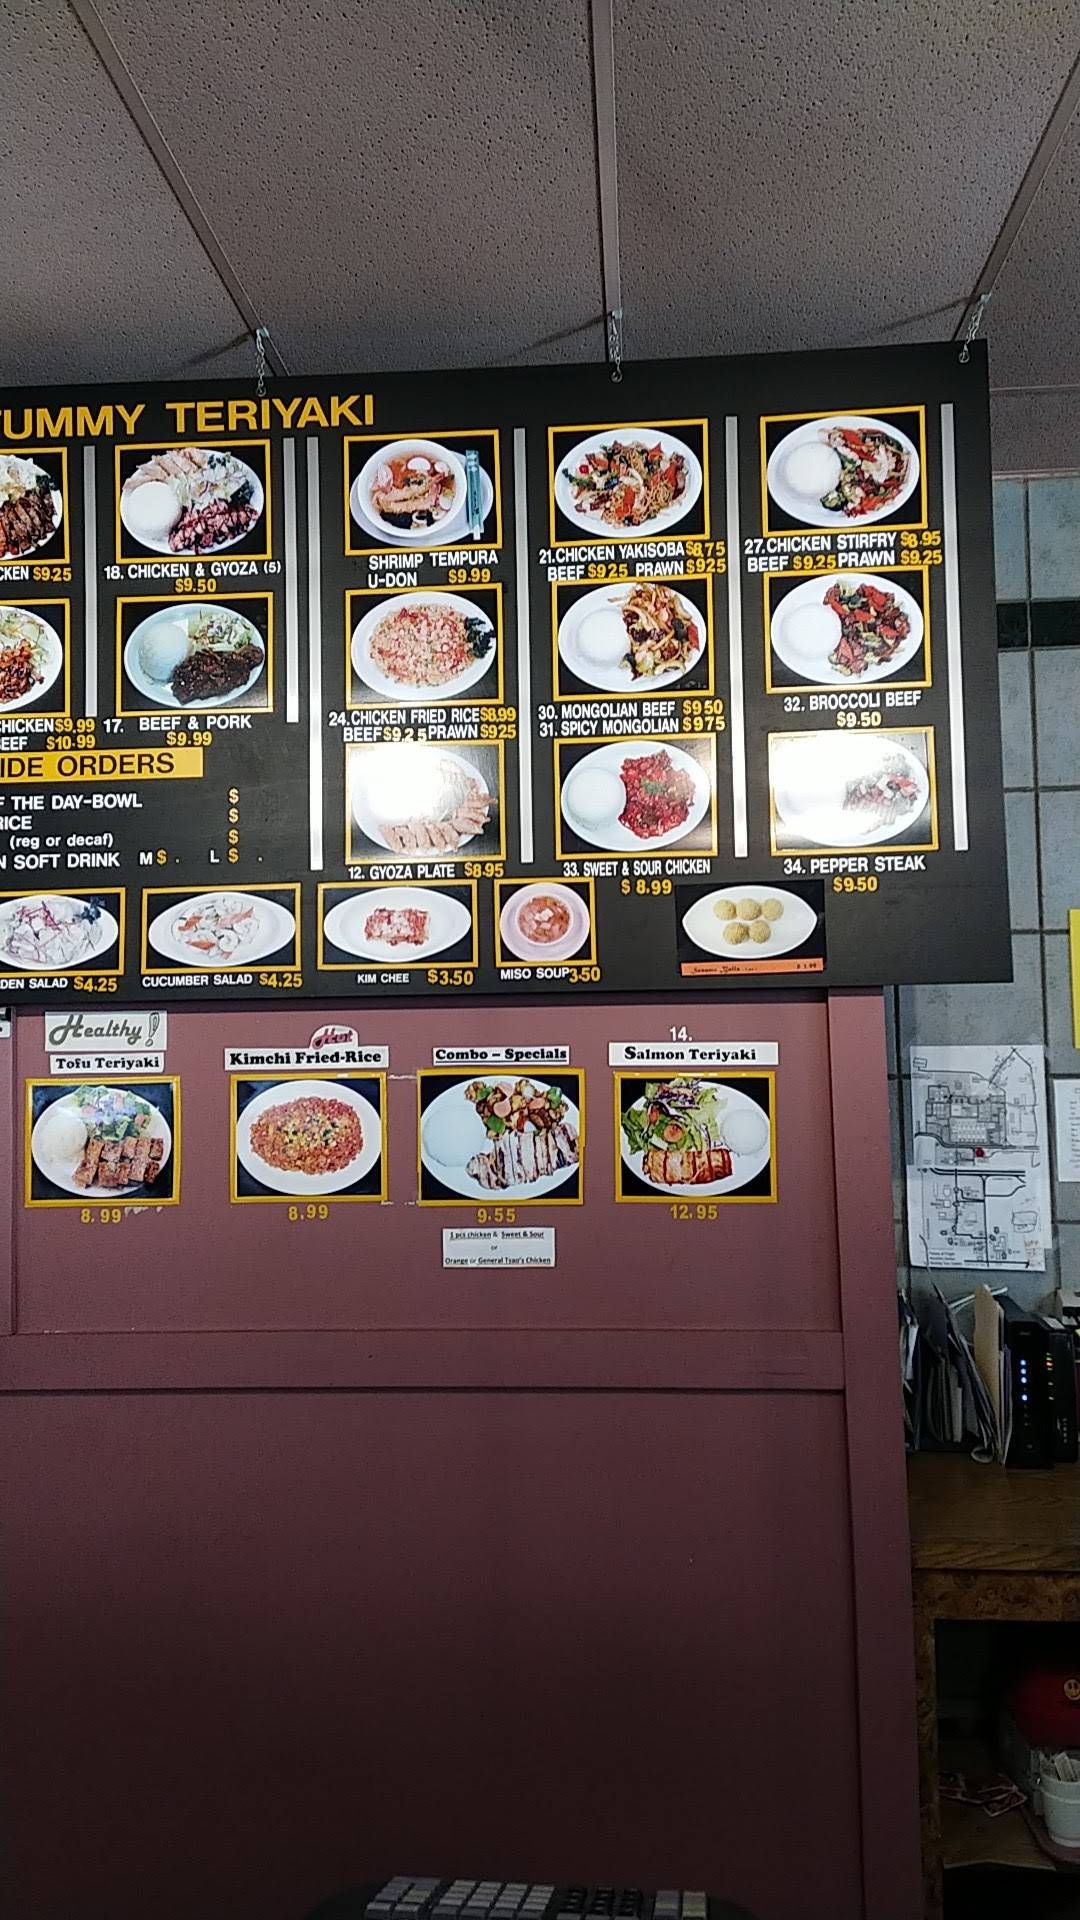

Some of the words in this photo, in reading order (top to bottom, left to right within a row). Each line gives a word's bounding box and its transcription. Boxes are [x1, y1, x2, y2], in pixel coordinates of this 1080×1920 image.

[0, 404, 145, 440] UMMY
[166, 394, 374, 433] TERIYAKI
[837, 532, 897, 550] STIRFRY
[900, 531, 941, 548] $8.95
[619, 541, 685, 559] YAKISOBA
[368, 553, 423, 570] SHRIMP
[429, 550, 498, 567] TEMPURA
[747, 556, 789, 572] BEEF
[792, 554, 836, 570] $9.25
[838, 551, 895, 567] PRAWN
[900, 550, 943, 565] $9.25
[33, 566, 72, 582] $9.25
[104, 565, 124, 580] 18.
[128, 563, 190, 579] CHICKEN
[196, 563, 204, 576] &
[211, 562, 259, 576] GYOZA
[263, 561, 281, 575] (5)
[368, 572, 417, 588] U-DON
[448, 568, 491, 583] $9.99
[547, 565, 584, 581] BEEF
[636, 561, 684, 577] PRAWN
[174, 578, 216, 593] $9.50
[784, 696, 805, 712] 32.
[810, 692, 880, 710] BROCCOLI
[886, 690, 921, 707] BEEF
[411, 709, 446, 724] FRIED
[451, 708, 479, 723] RICE
[480, 707, 516, 722] $8.99
[538, 705, 558, 720] 30.
[562, 702, 638, 718] MONGOLIAN
[642, 701, 675, 717] BEEF
[836, 711, 881, 727] $9.50
[0, 718, 54, 734] HICKEN
[55, 718, 95, 734] $9.99
[103, 719, 124, 733] 17.
[139, 717, 181, 731] BEEF
[187, 717, 198, 730] &
[206, 715, 252, 730] PORK
[540, 721, 557, 737] 31.
[561, 720, 598, 736] SPICY
[602, 718, 679, 735] MONGOLIAN
[166, 731, 213, 747] $9.99
[344, 727, 382, 742] BEEF
[428, 725, 478, 740] PRAWN
[0, 736, 28, 751] EEF
[46, 734, 96, 750] $10.99
[57, 752, 175, 776] ORDERS
[11, 794, 45, 811] THE
[51, 793, 142, 810] DAY-BOWL
[228, 787, 239, 805] $
[0, 815, 33, 831] ICE
[228, 807, 239, 824] $
[9, 834, 40, 850] (reg
[45, 835, 61, 848] or
[67, 833, 114, 847] decaf)
[228, 828, 239, 845] $
[13, 853, 61, 871] SOFT
[67, 852, 120, 868] DRINK
[139, 852, 153, 865] M
[156, 849, 168, 865] $
[210, 850, 220, 863] L
[228, 848, 239, 864] $
[562, 863, 580, 877] 33.
[583, 861, 618, 877] SWEET
[622, 861, 629, 876] &
[633, 860, 662, 876] SOUR
[666, 859, 711, 875] CHICKEN
[783, 857, 806, 874] 34.
[810, 857, 870, 874] PEPPER
[874, 855, 926, 872] STEAK
[348, 866, 365, 880] 12.
[370, 865, 412, 880] GYOZA
[416, 864, 456, 878] PLATE
[464, 862, 504, 878] $8.95
[832, 876, 879, 892] $9.50
[142, 976, 208, 988] CUCUMBER
[213, 974, 253, 986] SALAD
[259, 973, 303, 988] $4.25
[357, 974, 376, 984] KIM
[380, 972, 410, 984] CHEE
[427, 969, 474, 986] $3.50
[500, 969, 532, 980] MISO
[536, 967, 569, 980] SOUP
[28, 977, 68, 989] SALAD
[73, 976, 118, 992] $4.25
[670, 1026, 693, 1042] 14.
[230, 1052, 291, 1065] Kimchi
[295, 1051, 381, 1064] Fried-Rice
[436, 1049, 489, 1061] Combo
[504, 1048, 567, 1063] Specials
[625, 1045, 684, 1061] Salmon
[688, 1048, 757, 1062] Teriyaki
[56, 1058, 91, 1070] Tofu
[95, 1056, 160, 1069] Teriyaki
[81, 1208, 122, 1223] 8.99
[288, 1204, 329, 1221] 8.99
[477, 1207, 516, 1223] 9.55
[670, 1204, 718, 1220] 12.95
